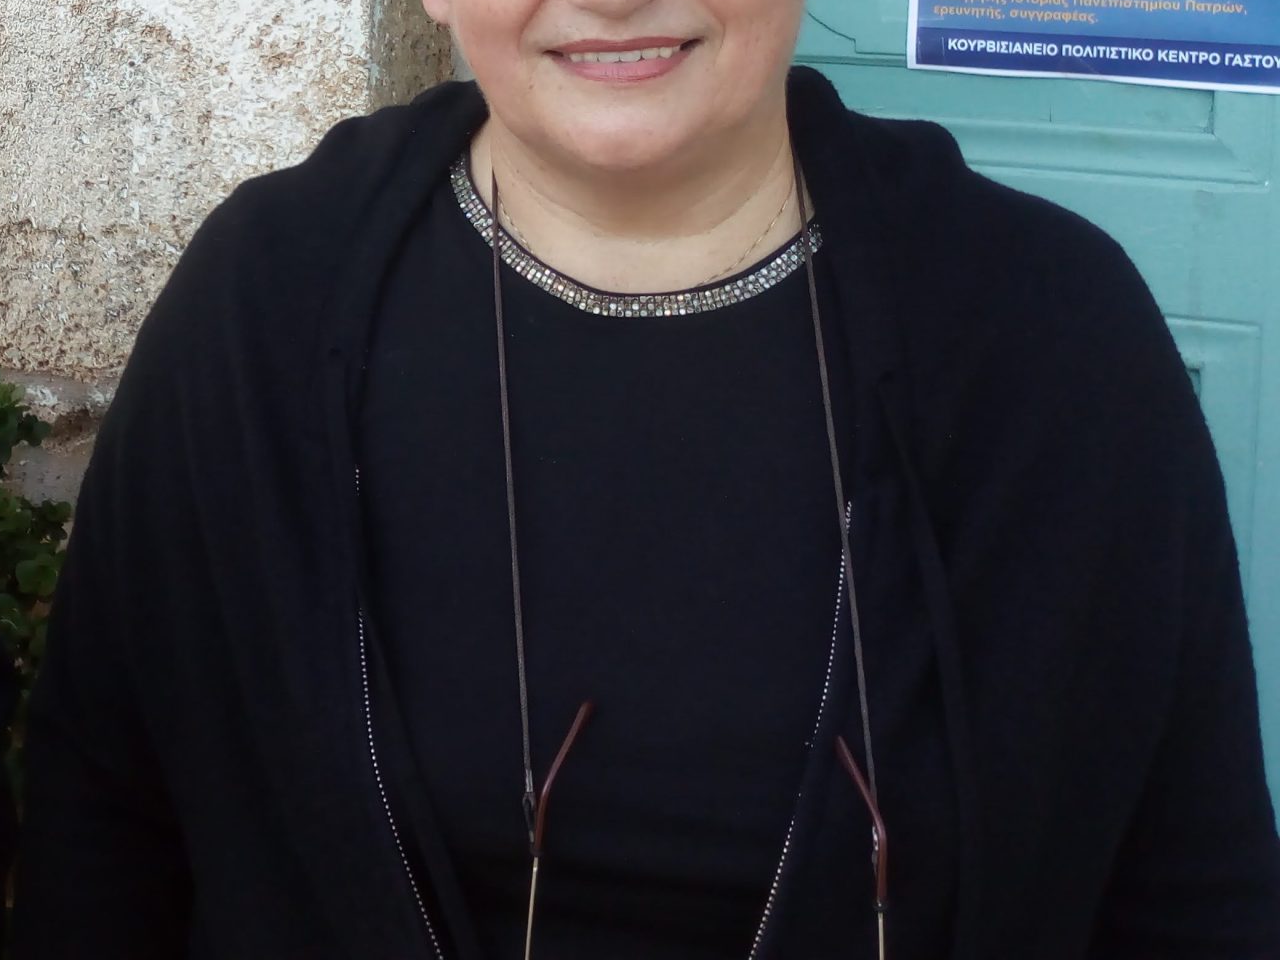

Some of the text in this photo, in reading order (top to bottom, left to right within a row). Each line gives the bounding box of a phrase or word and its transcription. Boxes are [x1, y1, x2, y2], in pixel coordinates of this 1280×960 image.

[948, 38, 1058, 56] ΚΟΥΡΒΙΣΙΑΝΕΙΟ
[1062, 43, 1154, 61] ΠΟΛΙΤΙΣΤΙΚΟ
[1157, 49, 1221, 66] ΚΕΝΤΡΟ
